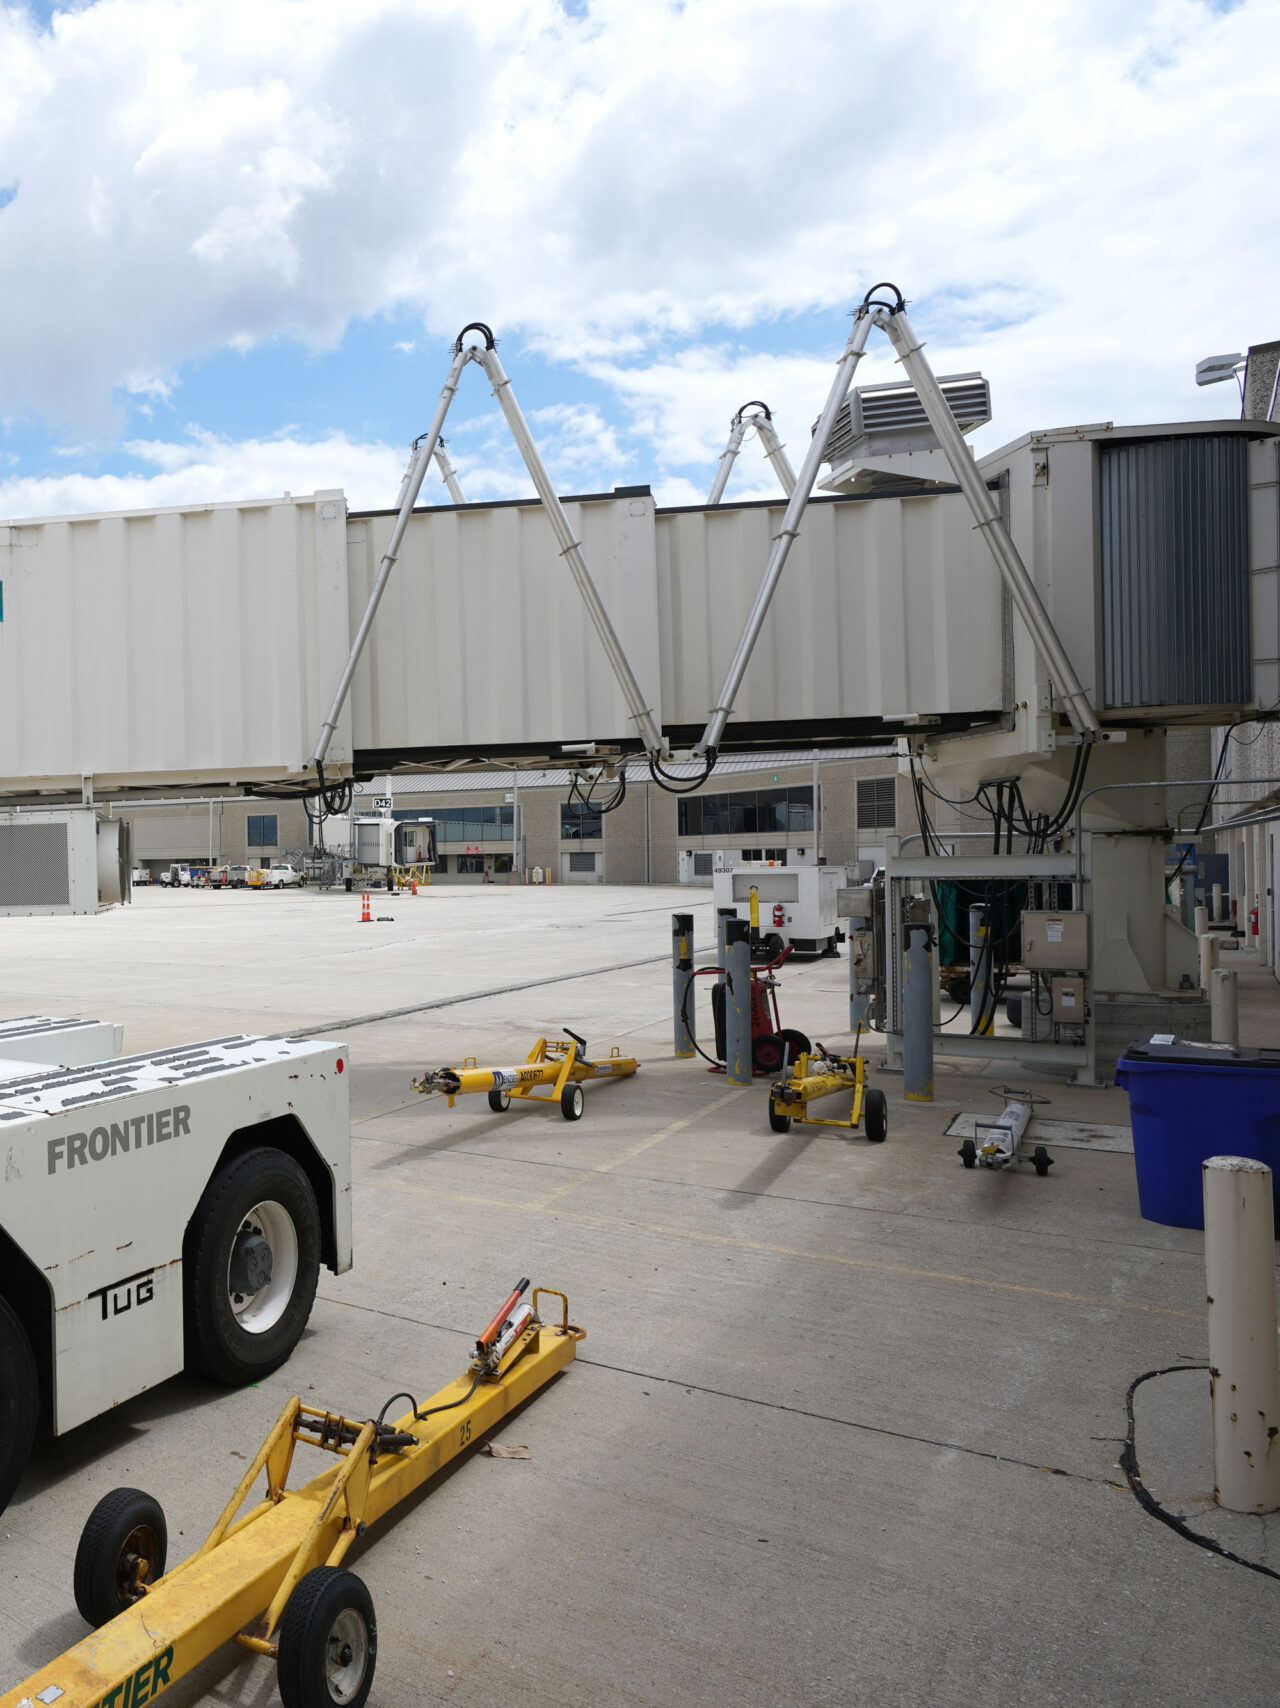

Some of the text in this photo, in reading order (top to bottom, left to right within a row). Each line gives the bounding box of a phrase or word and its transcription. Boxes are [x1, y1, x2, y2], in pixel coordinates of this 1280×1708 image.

[374, 799, 391, 807] D42
[47, 1104, 192, 1176] FRONTIER
[87, 1267, 155, 1321] TUG
[459, 1418, 472, 1447] 25
[92, 1644, 174, 1708] TIER
